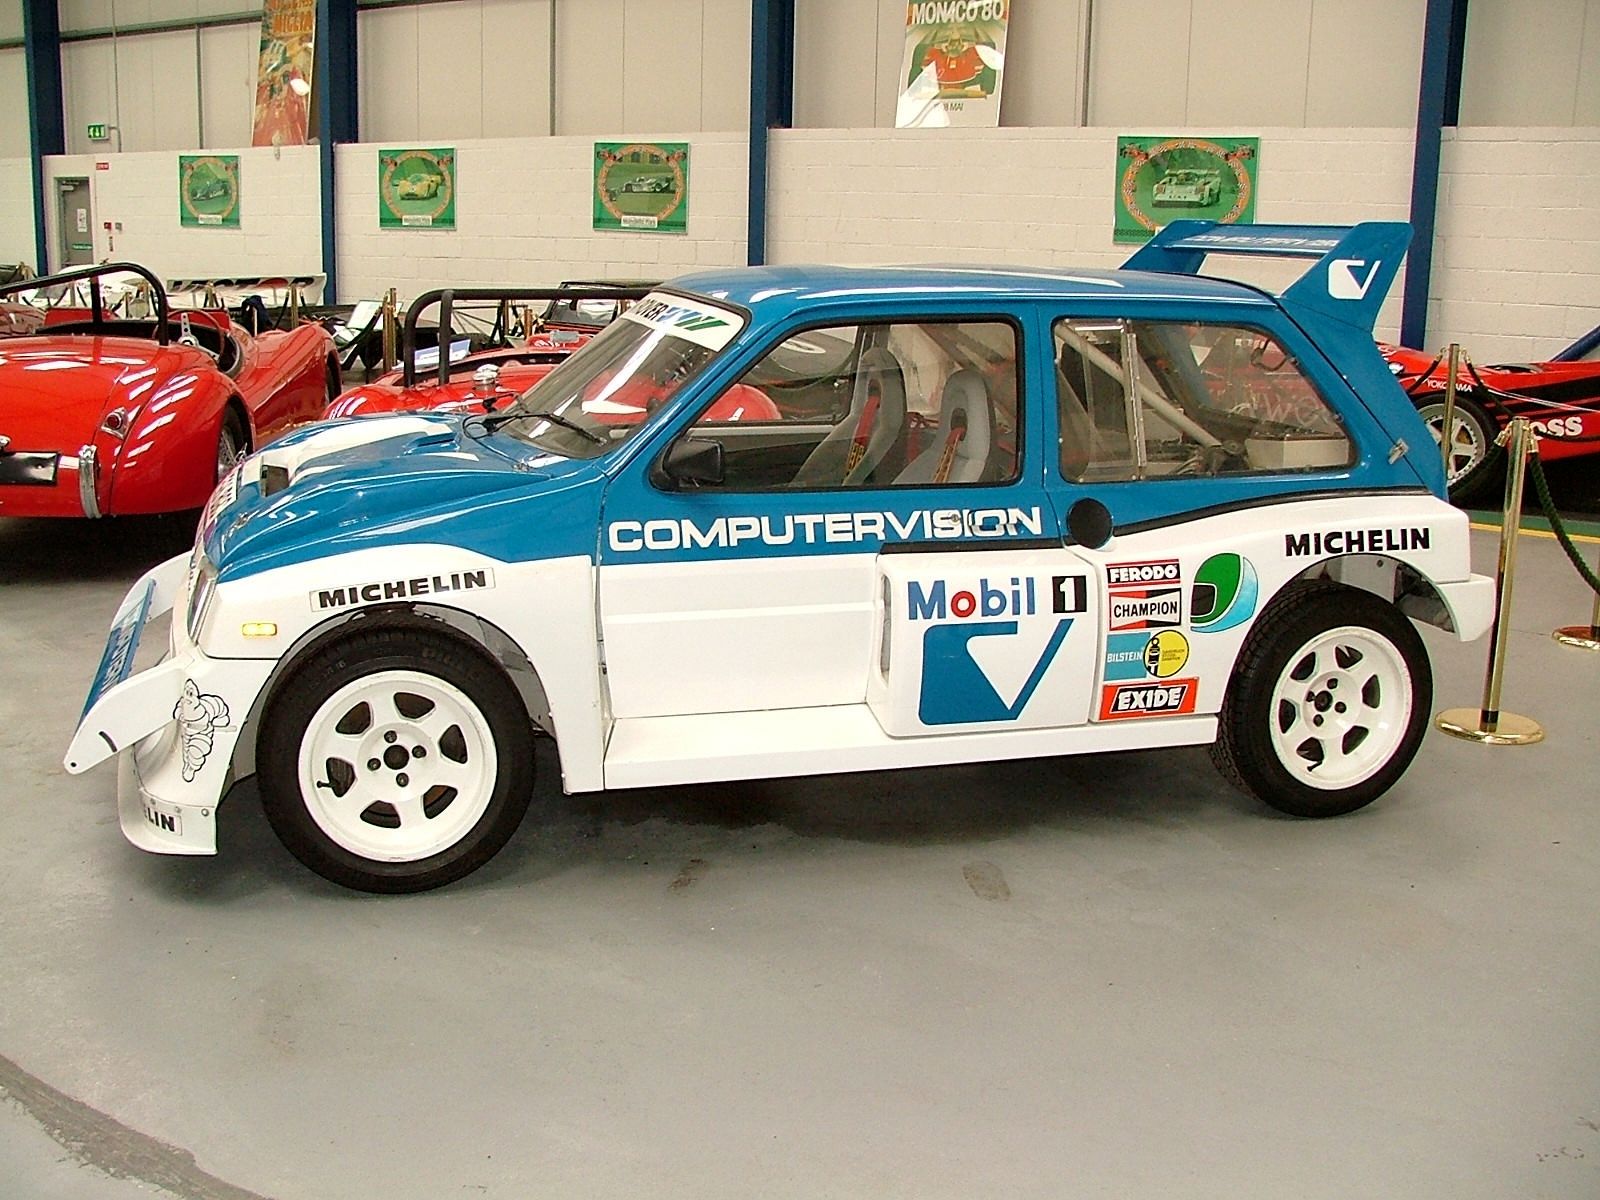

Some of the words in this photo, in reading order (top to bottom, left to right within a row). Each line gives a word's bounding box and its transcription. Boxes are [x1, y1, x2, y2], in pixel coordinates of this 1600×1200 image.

[911, 0, 978, 25] MONACO
[1427, 377, 1473, 393] YOKOAMA
[608, 506, 1042, 551] COMPUTERVISION
[1285, 528, 1430, 556] MICHELIN
[1109, 564, 1178, 583] FERODO
[318, 570, 487, 609] MICHELIN
[907, 576, 1036, 620] Mobil
[1113, 600, 1178, 618] CHAMPION
[1107, 651, 1143, 663] BILSTEIN
[1117, 687, 1182, 711] EXIDE
[144, 805, 175, 832] LIN
